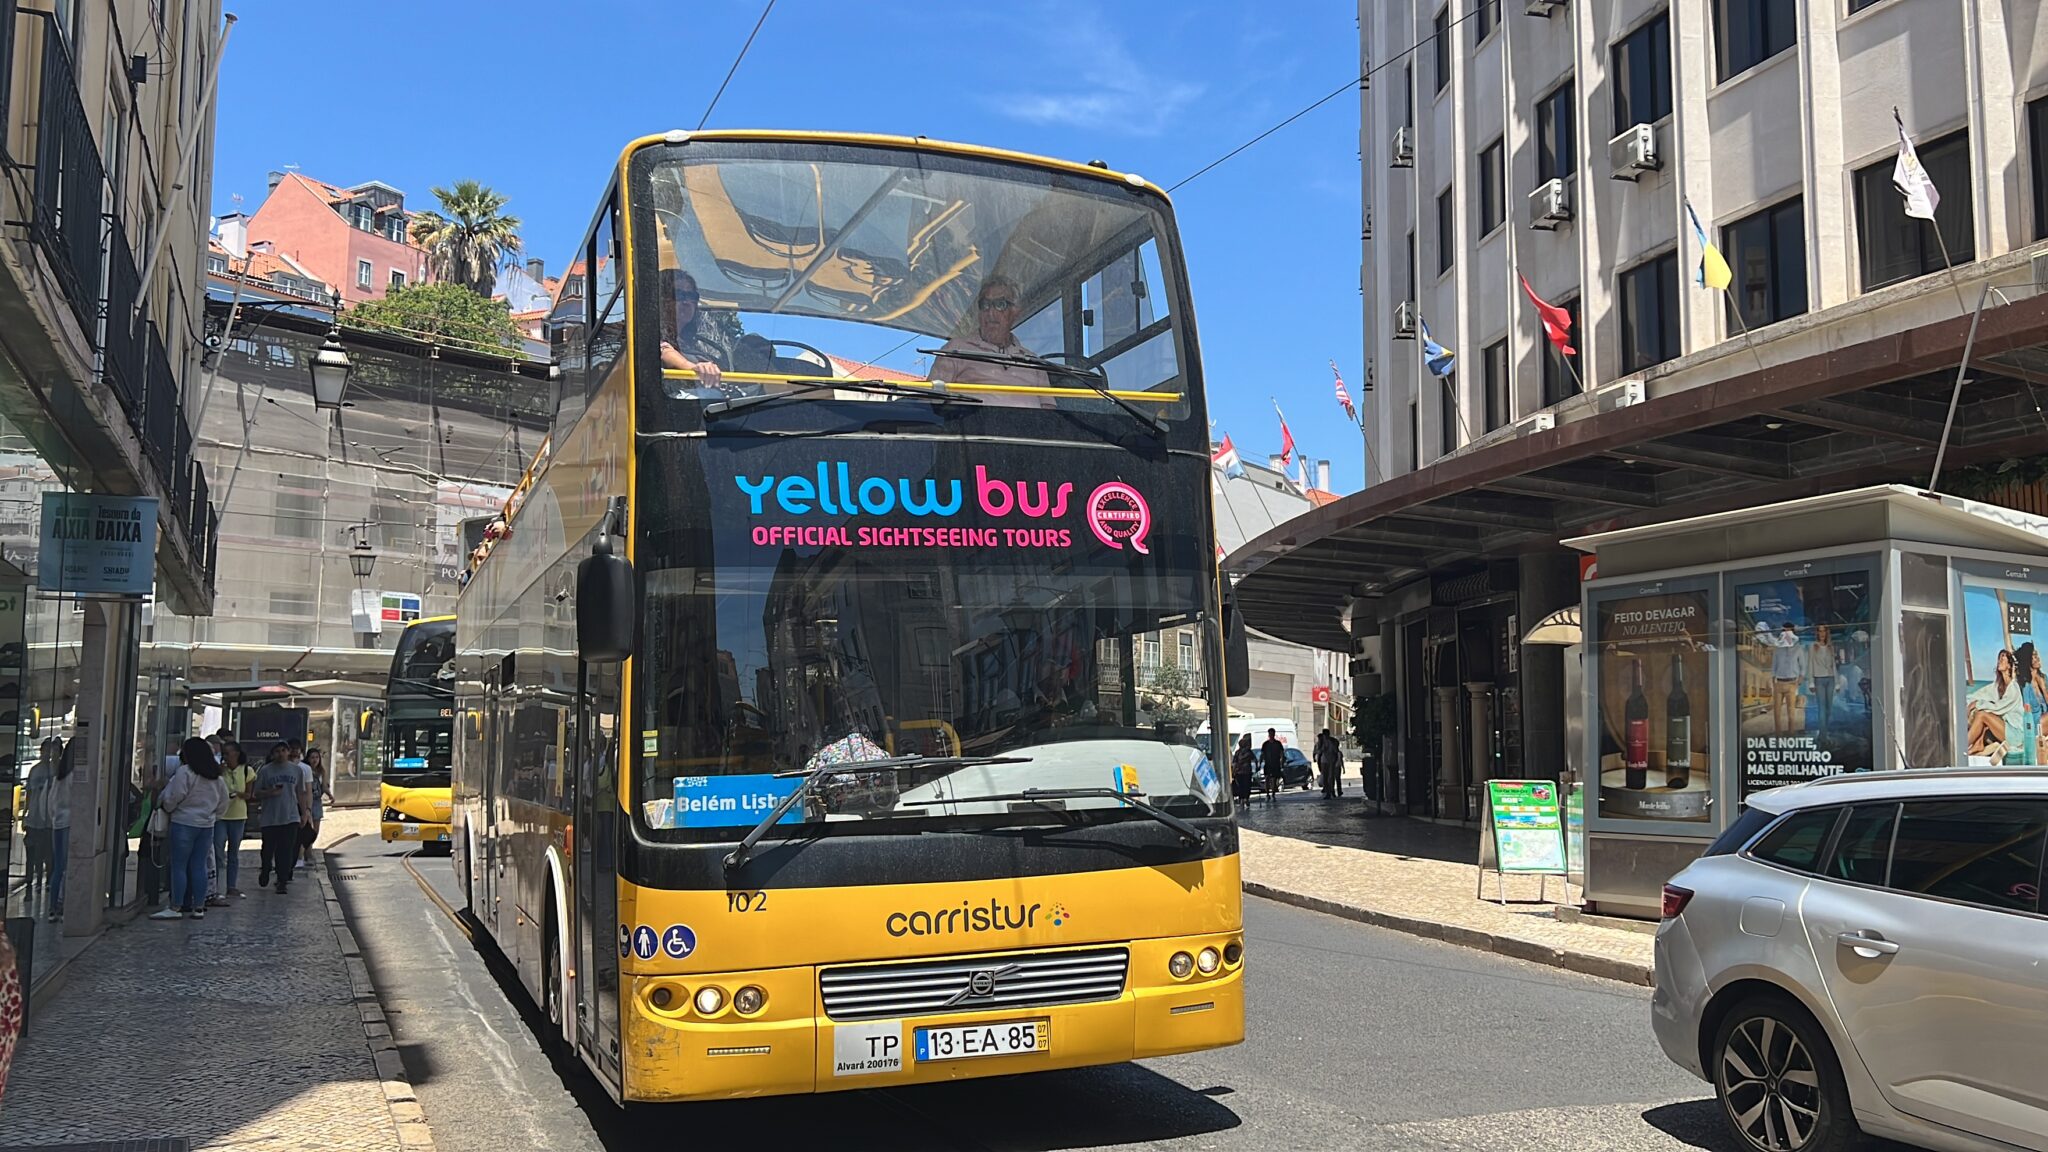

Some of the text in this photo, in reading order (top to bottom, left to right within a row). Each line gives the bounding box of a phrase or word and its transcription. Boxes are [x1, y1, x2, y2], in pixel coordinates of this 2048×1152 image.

[735, 461, 1074, 518] yellow bus
[1098, 492, 1137, 509] EXCELLENCE
[131, 508, 141, 520] da
[95, 520, 142, 542] BAIXA
[752, 526, 1073, 548] OFFICIAL SIGHTSEEING TOURS
[1100, 521, 1139, 538] AND QUALITY
[1614, 606, 1695, 623] FEITO DEVAGAR
[1622, 621, 1686, 636] NO ALENTEJO
[1747, 738, 1817, 751] DIA E NOITE,
[1747, 751, 1832, 763] O TEU FUTURO
[1747, 764, 1775, 775] MAIS
[676, 792, 802, 815] Belém Lisb
[726, 891, 767, 913] 102
[885, 898, 1041, 938] carristur
[1037, 1025, 1046, 1034] 07
[865, 1035, 899, 1057] TP
[1038, 1039, 1048, 1049] 07
[837, 1058, 899, 1072] Alvará 200176
